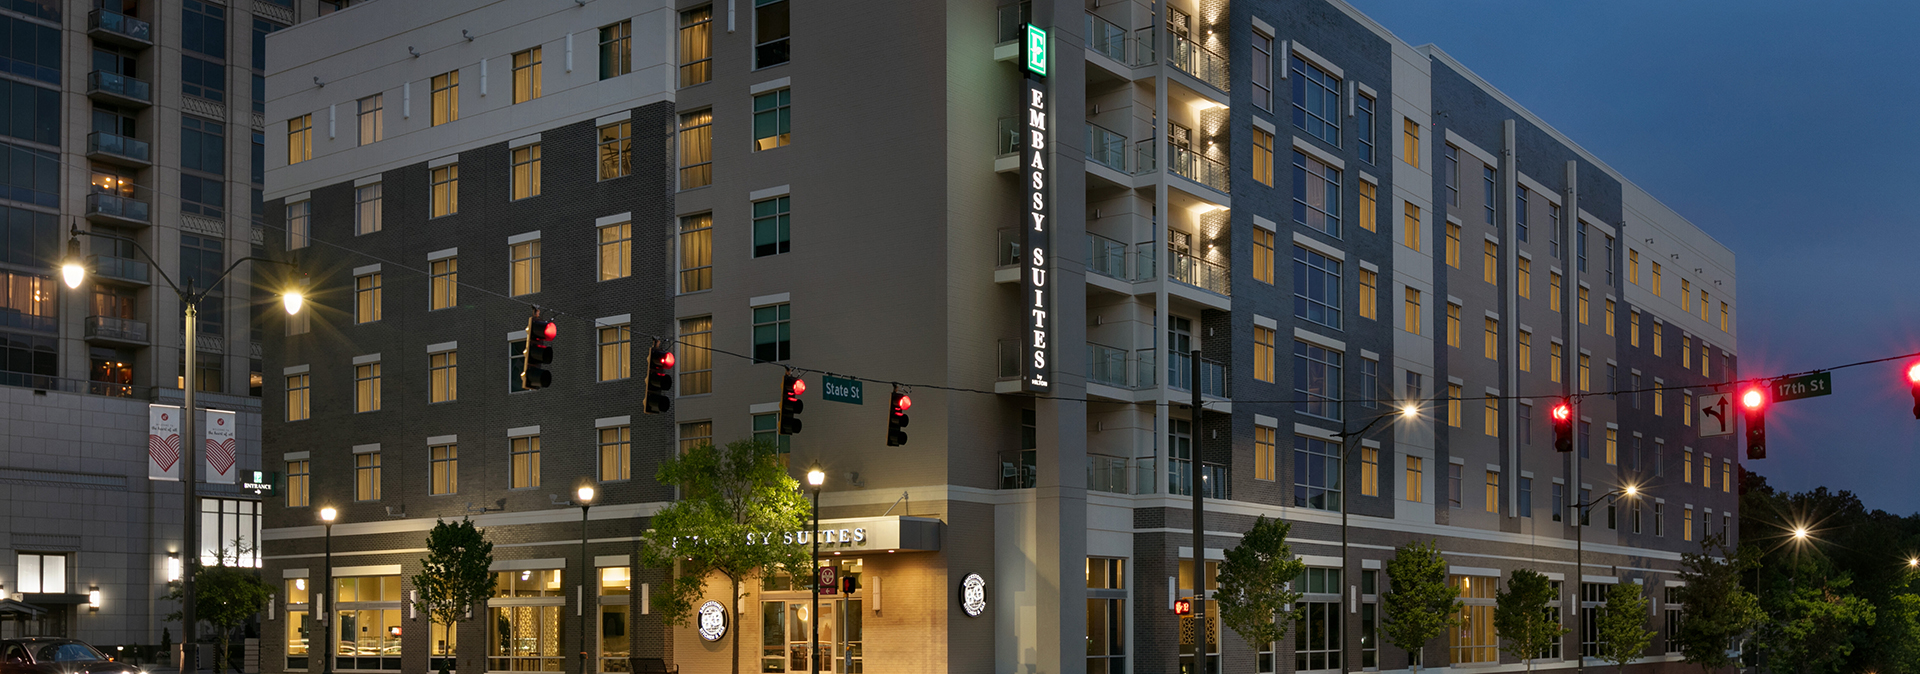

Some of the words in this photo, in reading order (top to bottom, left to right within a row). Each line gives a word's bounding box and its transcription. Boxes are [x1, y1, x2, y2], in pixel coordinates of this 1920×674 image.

[1029, 88, 1046, 232] EMBASSY
[1031, 247, 1046, 370] SUITES
[826, 382, 849, 397] State
[850, 386, 860, 399] St
[1778, 383, 1806, 396] 17th
[1810, 379, 1825, 391] St
[783, 528, 864, 545] SUTES
